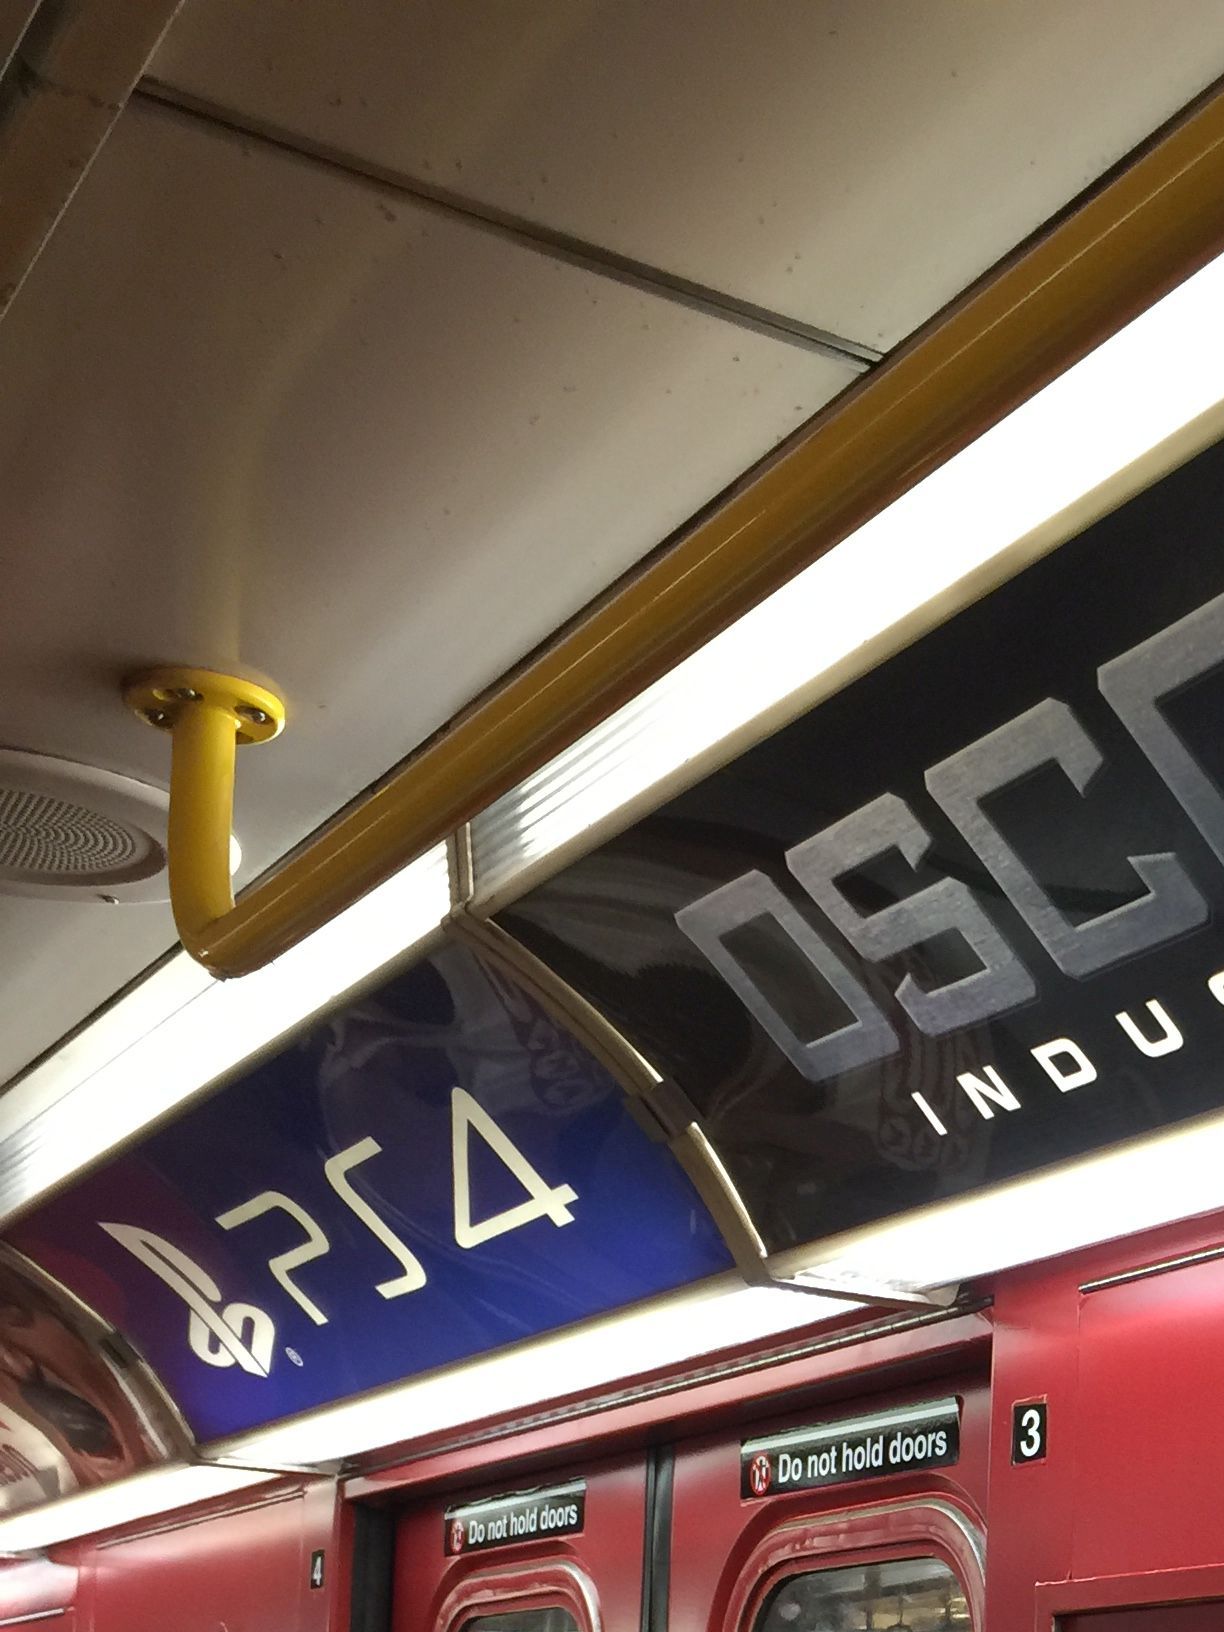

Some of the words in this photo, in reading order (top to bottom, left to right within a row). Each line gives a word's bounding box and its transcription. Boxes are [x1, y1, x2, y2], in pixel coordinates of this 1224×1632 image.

[215, 1086, 579, 1326] PS4
[778, 1453, 802, 1483] Do
[807, 1446, 837, 1478] not
[842, 1435, 884, 1473] hold
[889, 1431, 947, 1464] doors
[1020, 1409, 1040, 1457] 3
[468, 1520, 485, 1544] Do
[487, 1516, 507, 1540] not
[510, 1506, 537, 1536] hold
[540, 1504, 578, 1530] doors
[313, 1556, 322, 1586] 4
